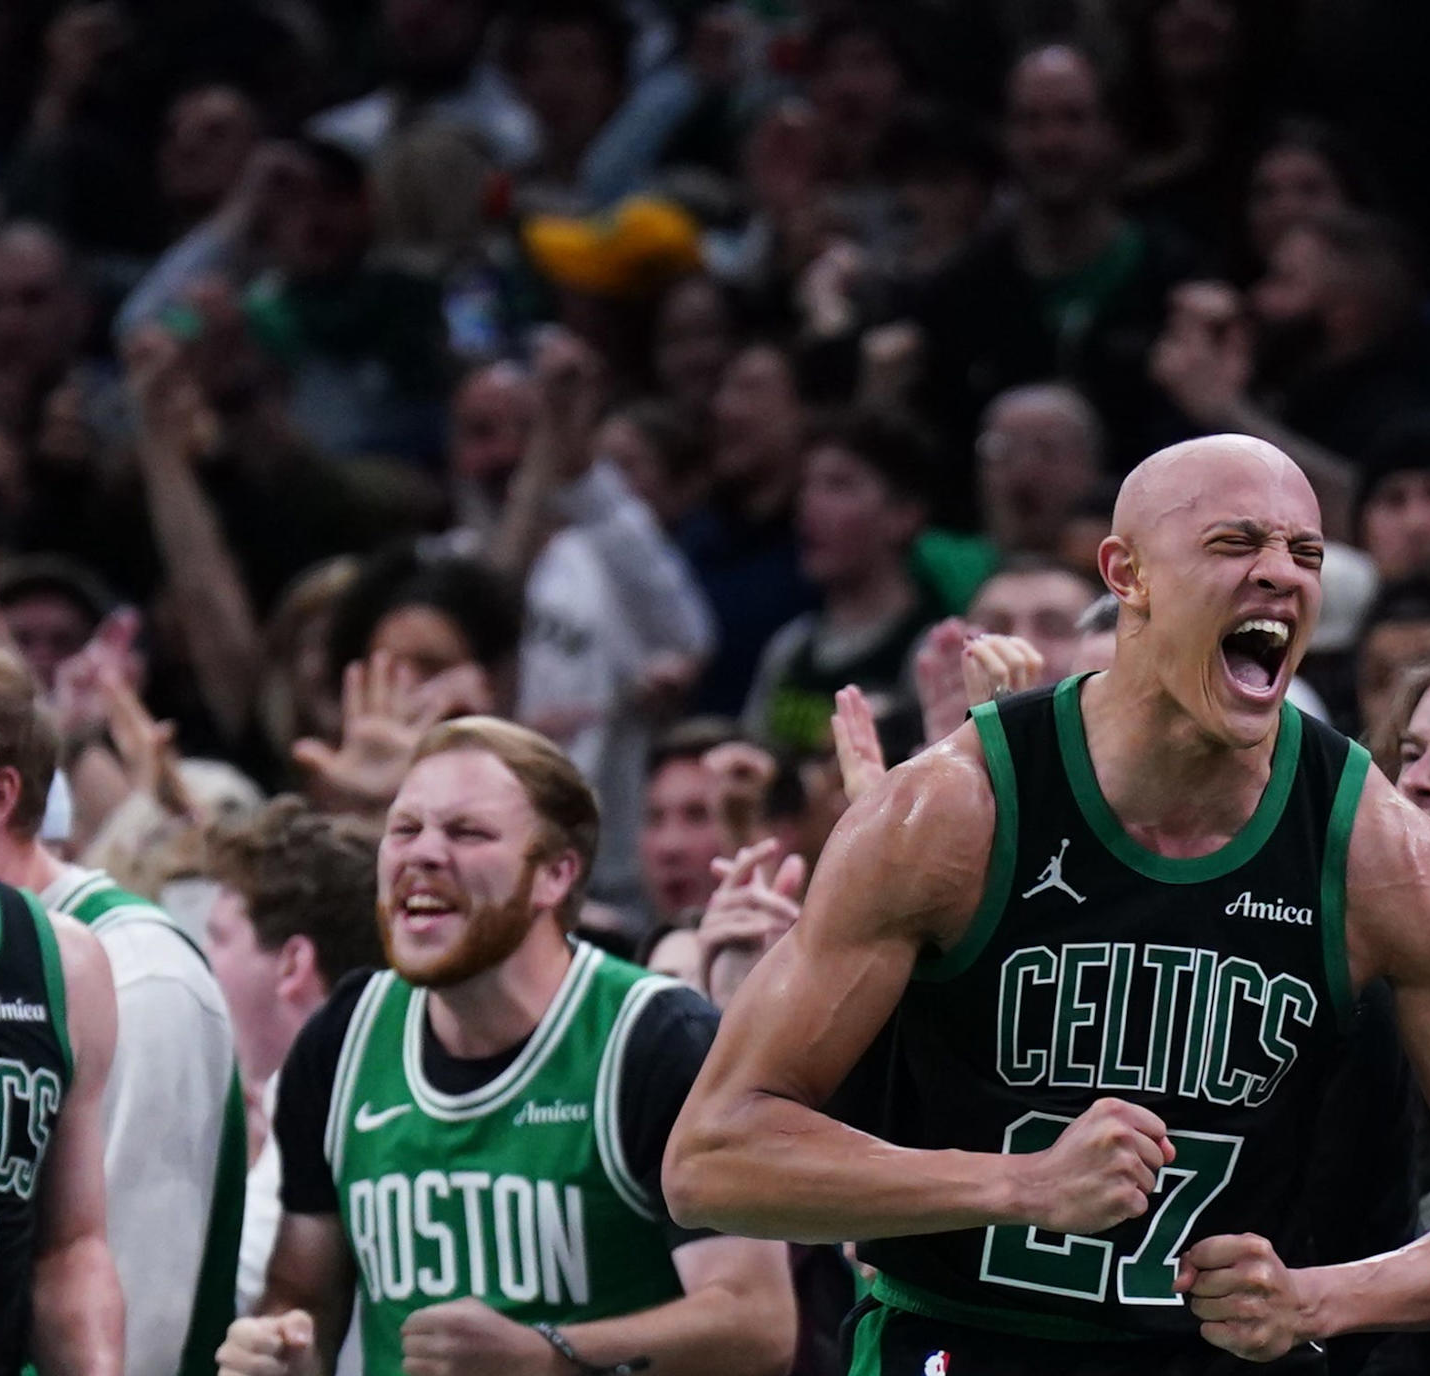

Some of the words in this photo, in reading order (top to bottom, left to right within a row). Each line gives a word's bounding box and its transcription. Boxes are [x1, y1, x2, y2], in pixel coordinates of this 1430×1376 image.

[1224, 890, 1314, 927] Amica
[995, 942, 1319, 1108] CELTICS
[512, 1099, 589, 1128] Amica
[348, 1169, 590, 1307] BOSTON
[978, 1110, 1245, 1307] 27
